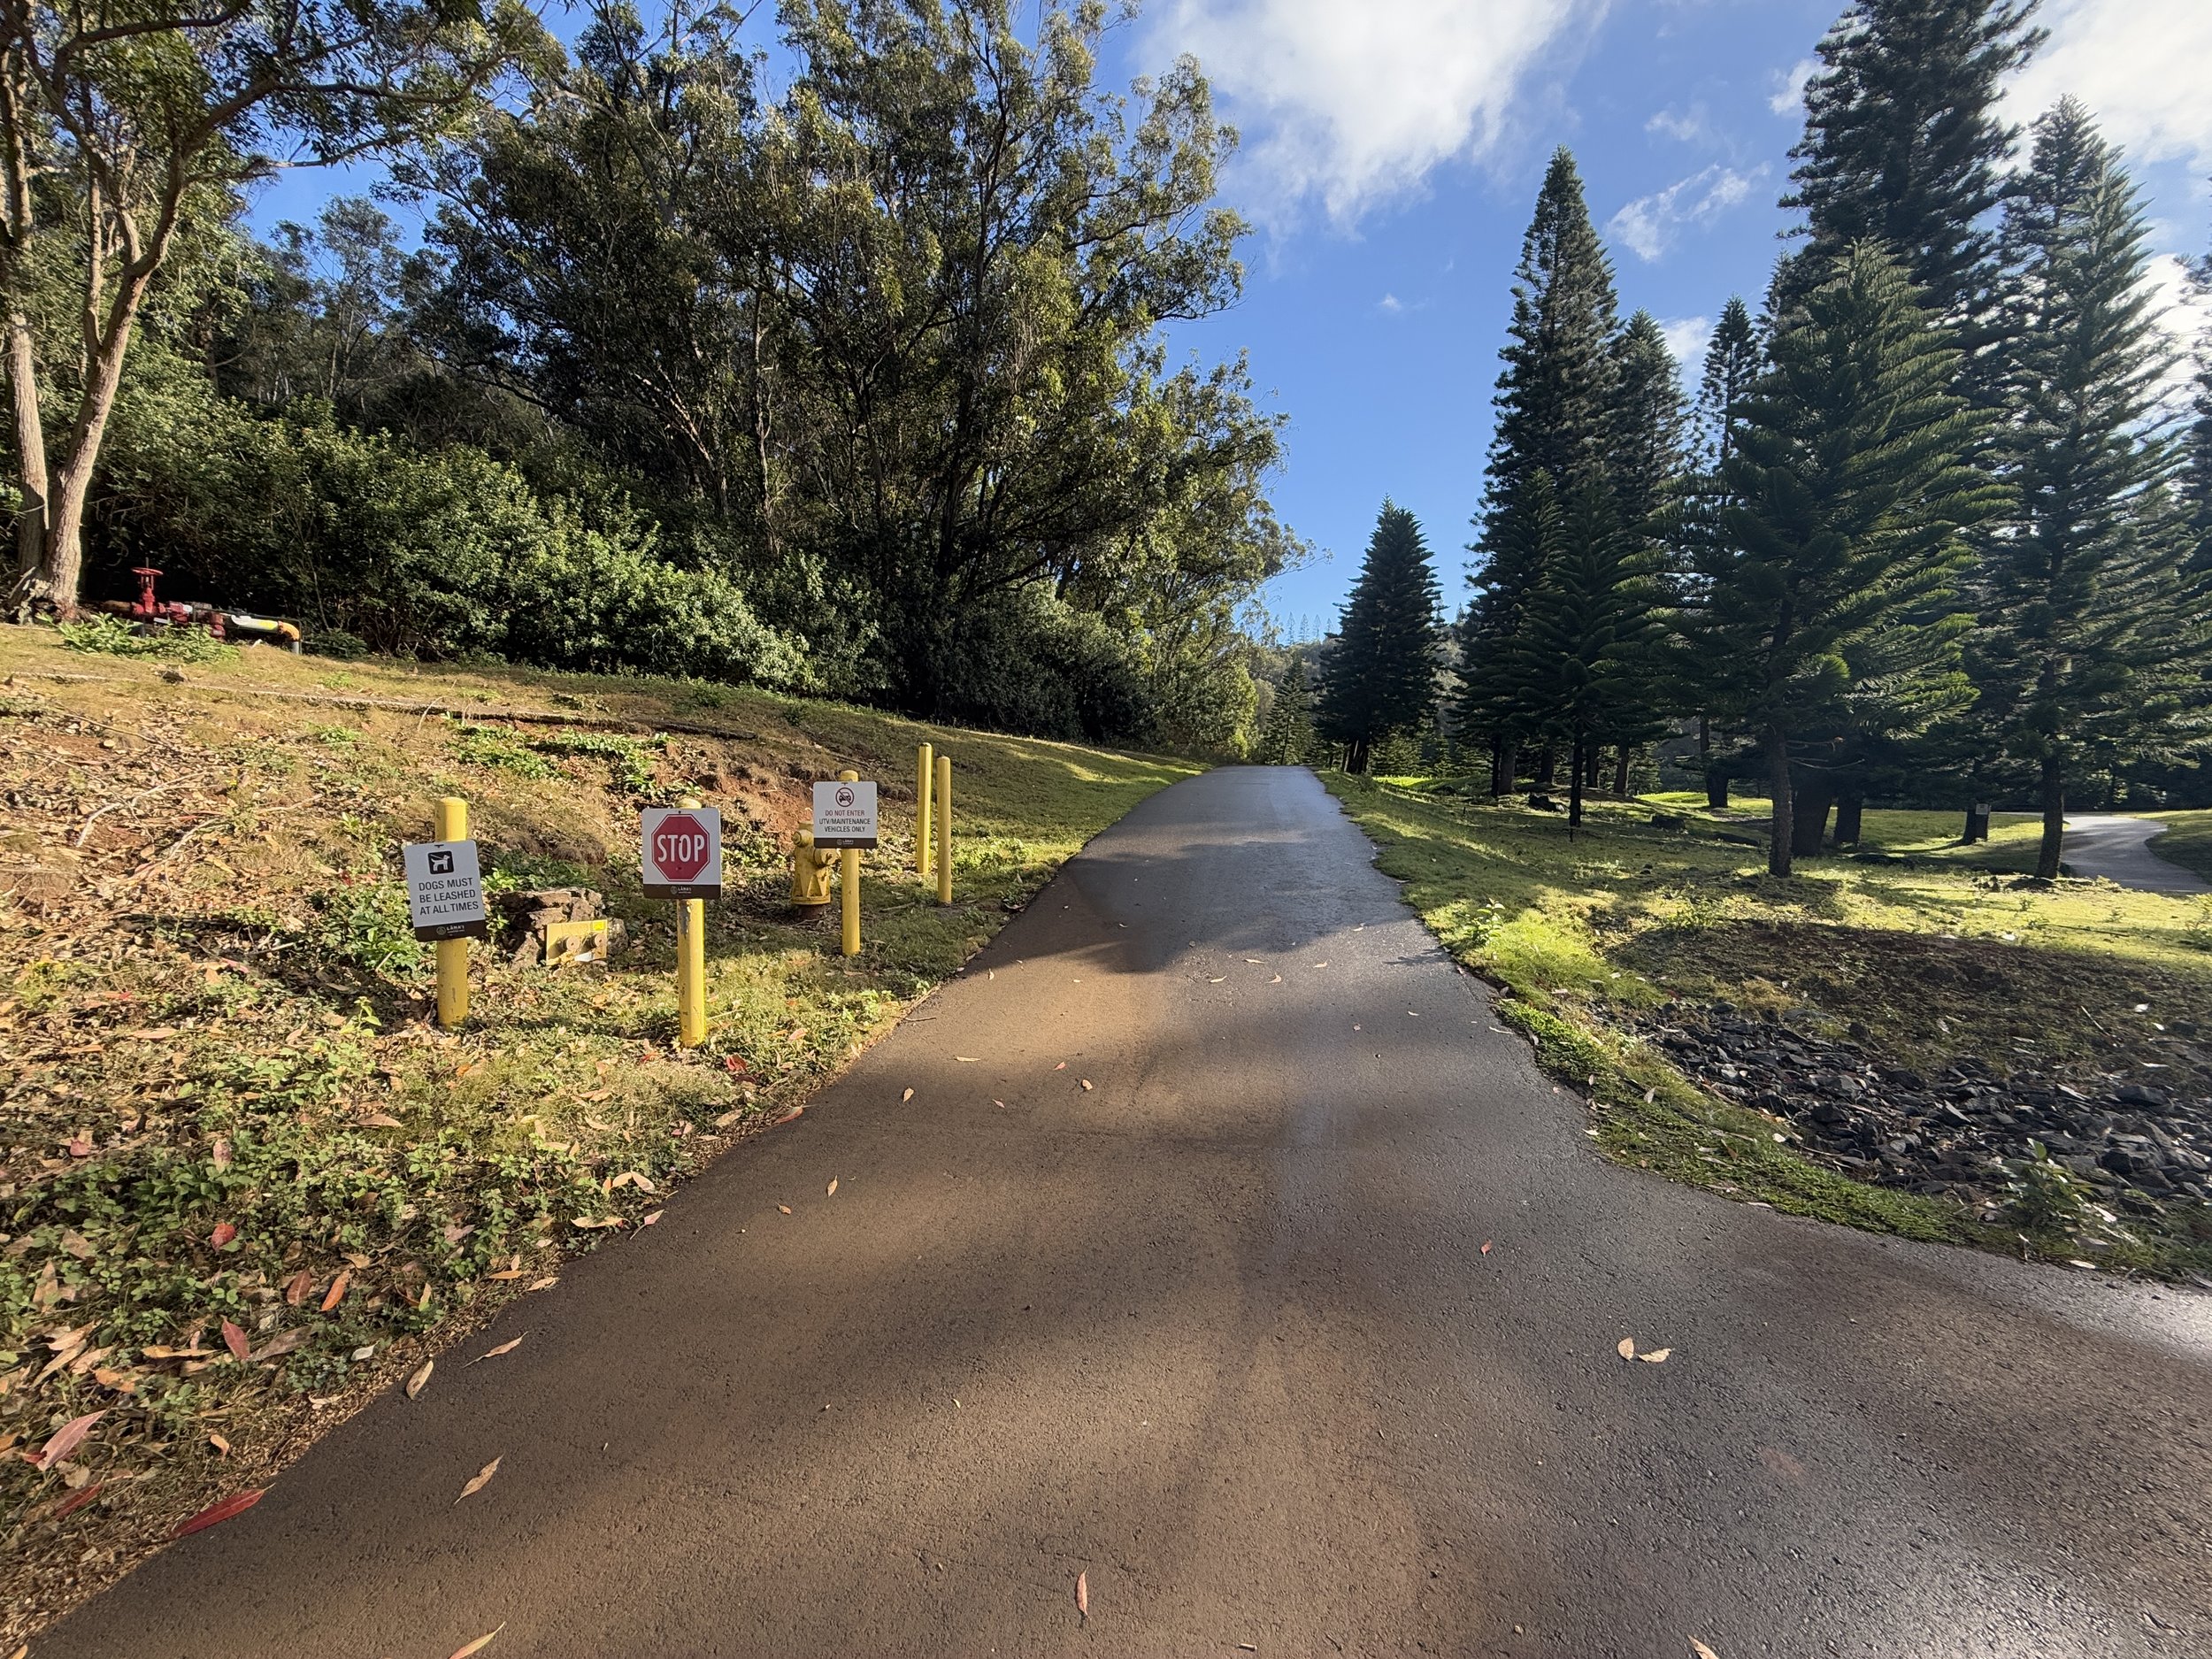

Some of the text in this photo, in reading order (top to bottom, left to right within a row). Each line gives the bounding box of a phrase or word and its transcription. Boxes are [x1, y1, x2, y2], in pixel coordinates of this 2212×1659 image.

[657, 834, 705, 862] STOP
[419, 878, 472, 891] DOGS MUST
[419, 889, 476, 902] BE LEASHED
[420, 901, 479, 915] AT ALL TIMES
